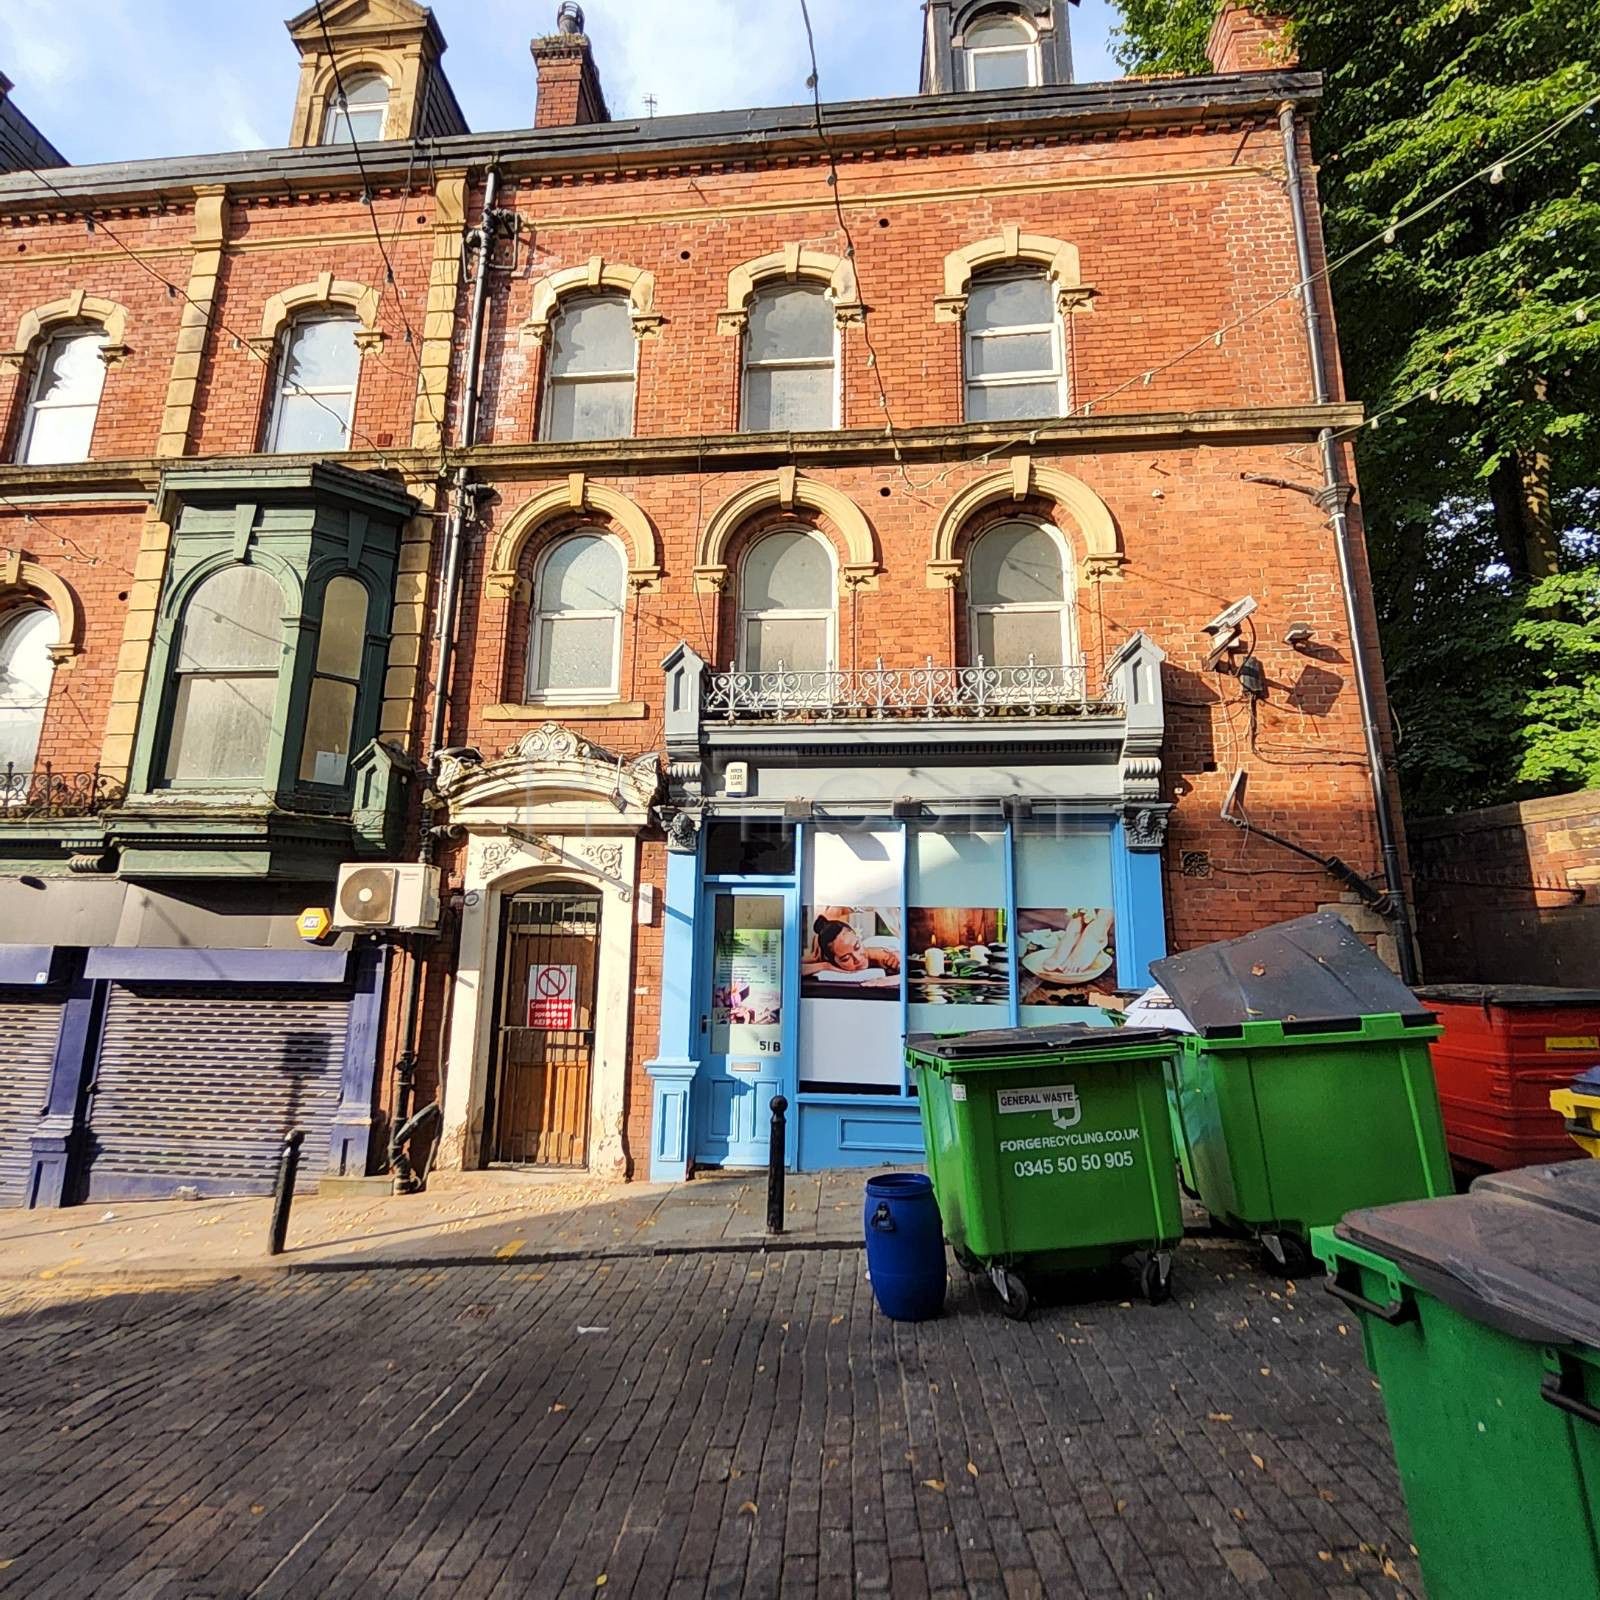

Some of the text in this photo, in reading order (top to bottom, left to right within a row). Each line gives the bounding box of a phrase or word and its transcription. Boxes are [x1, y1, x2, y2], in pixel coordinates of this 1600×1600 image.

[1001, 1092, 1073, 1106] GENERAL WASTE
[1000, 1128, 1140, 1152] FORGERECYCLING.CO.UK
[1014, 1151, 1134, 1177] 0345 50 50 905
